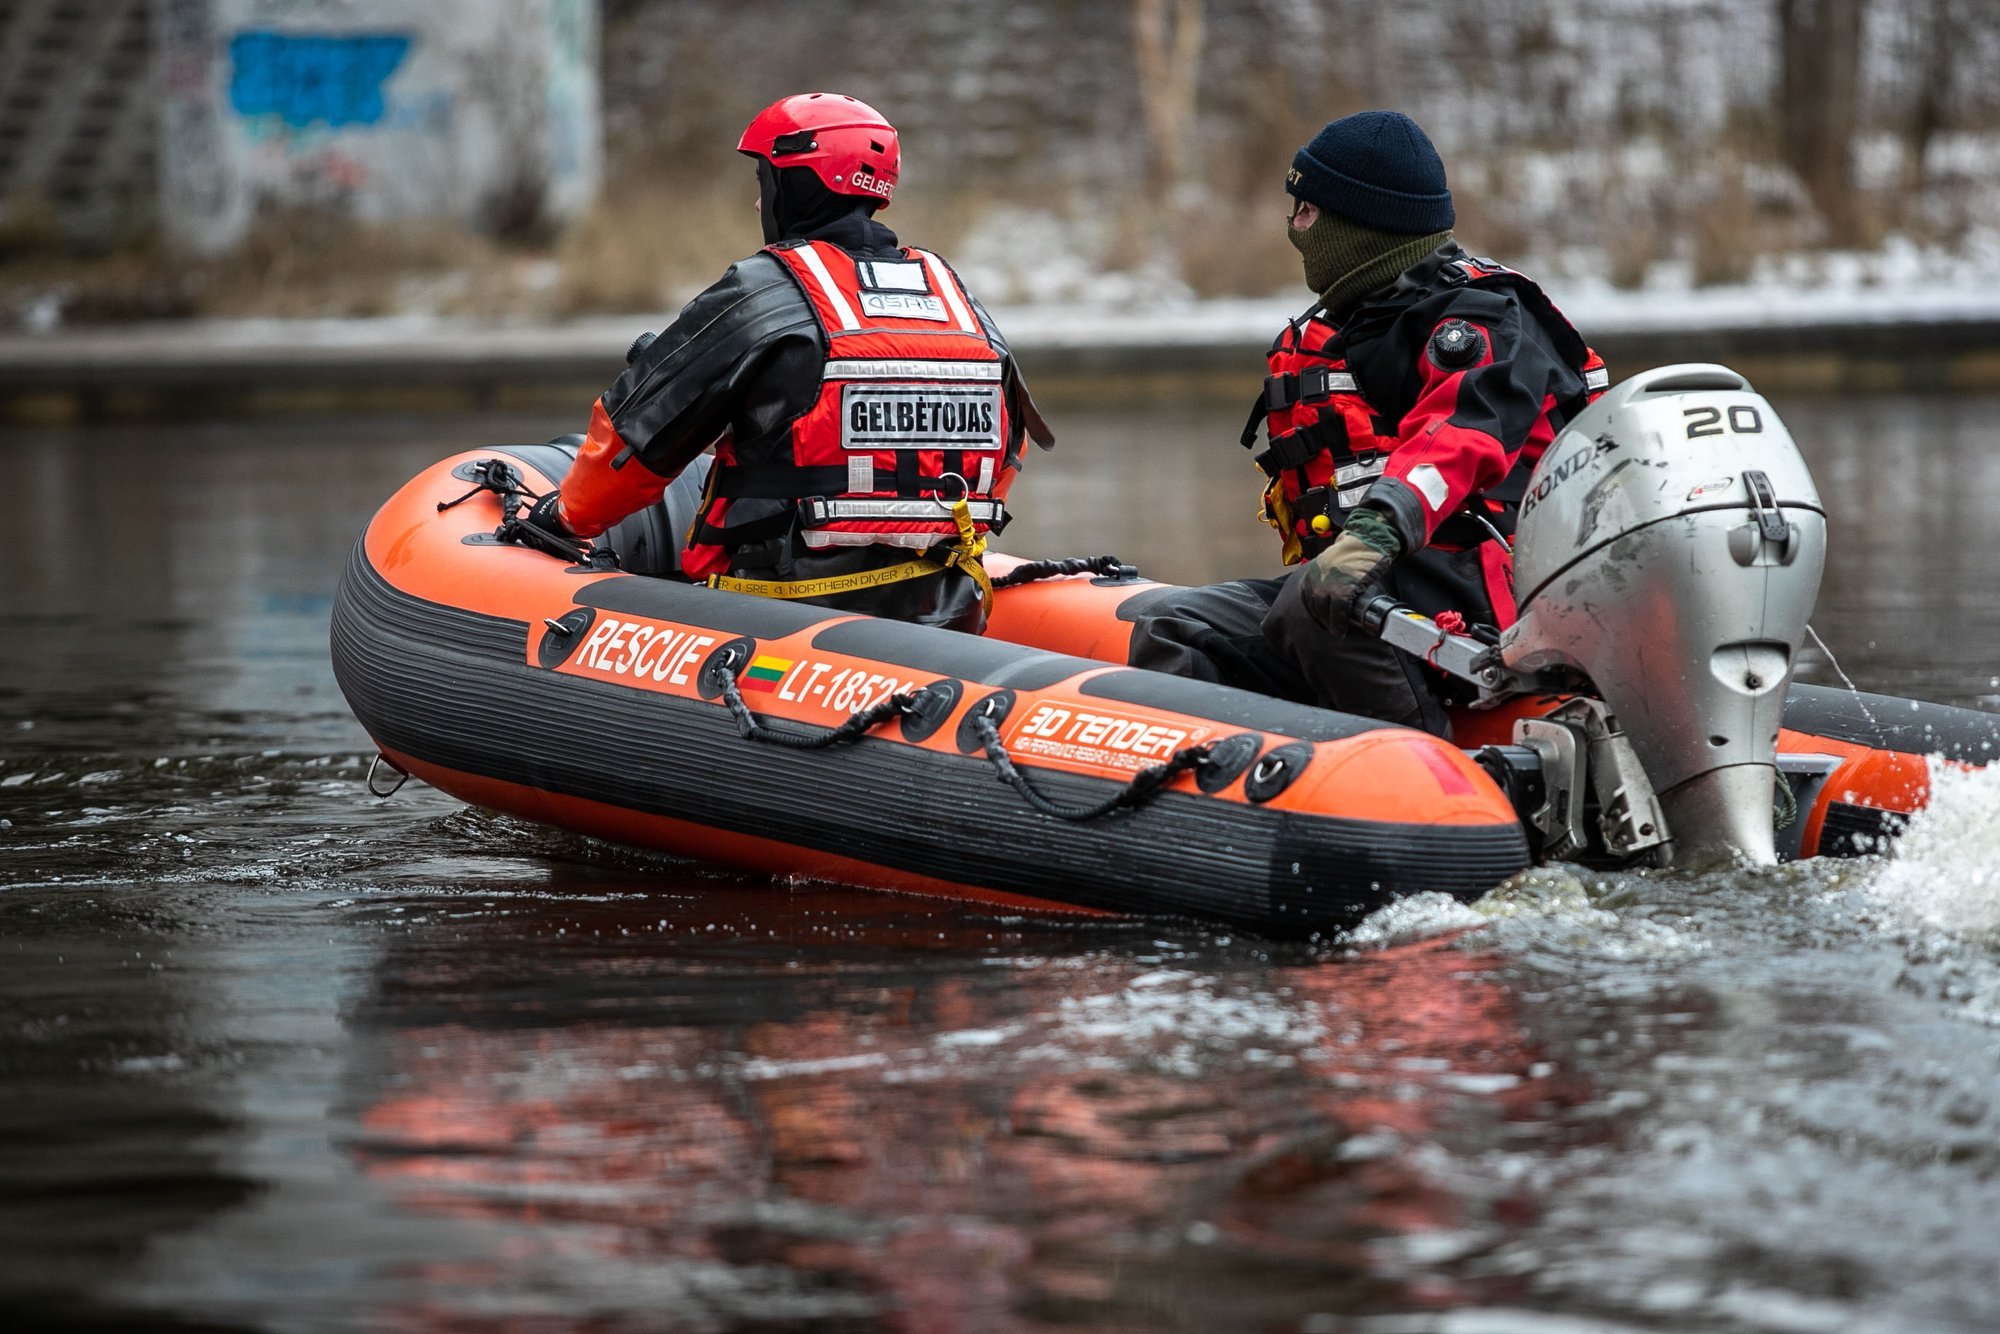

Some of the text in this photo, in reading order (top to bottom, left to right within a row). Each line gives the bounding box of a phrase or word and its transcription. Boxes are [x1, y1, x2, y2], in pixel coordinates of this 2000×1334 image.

[851, 396, 992, 433] GELBĖTOJAS
[1683, 405, 1763, 439] 20
[1523, 436, 1619, 518] HONDA
[746, 583, 768, 594] SRE
[789, 577, 858, 595] NORTHERN
[860, 570, 898, 584] DIVER
[576, 618, 716, 686] RESCUE
[1021, 706, 1071, 737] 3D
[1065, 713, 1187, 758] TENDER
